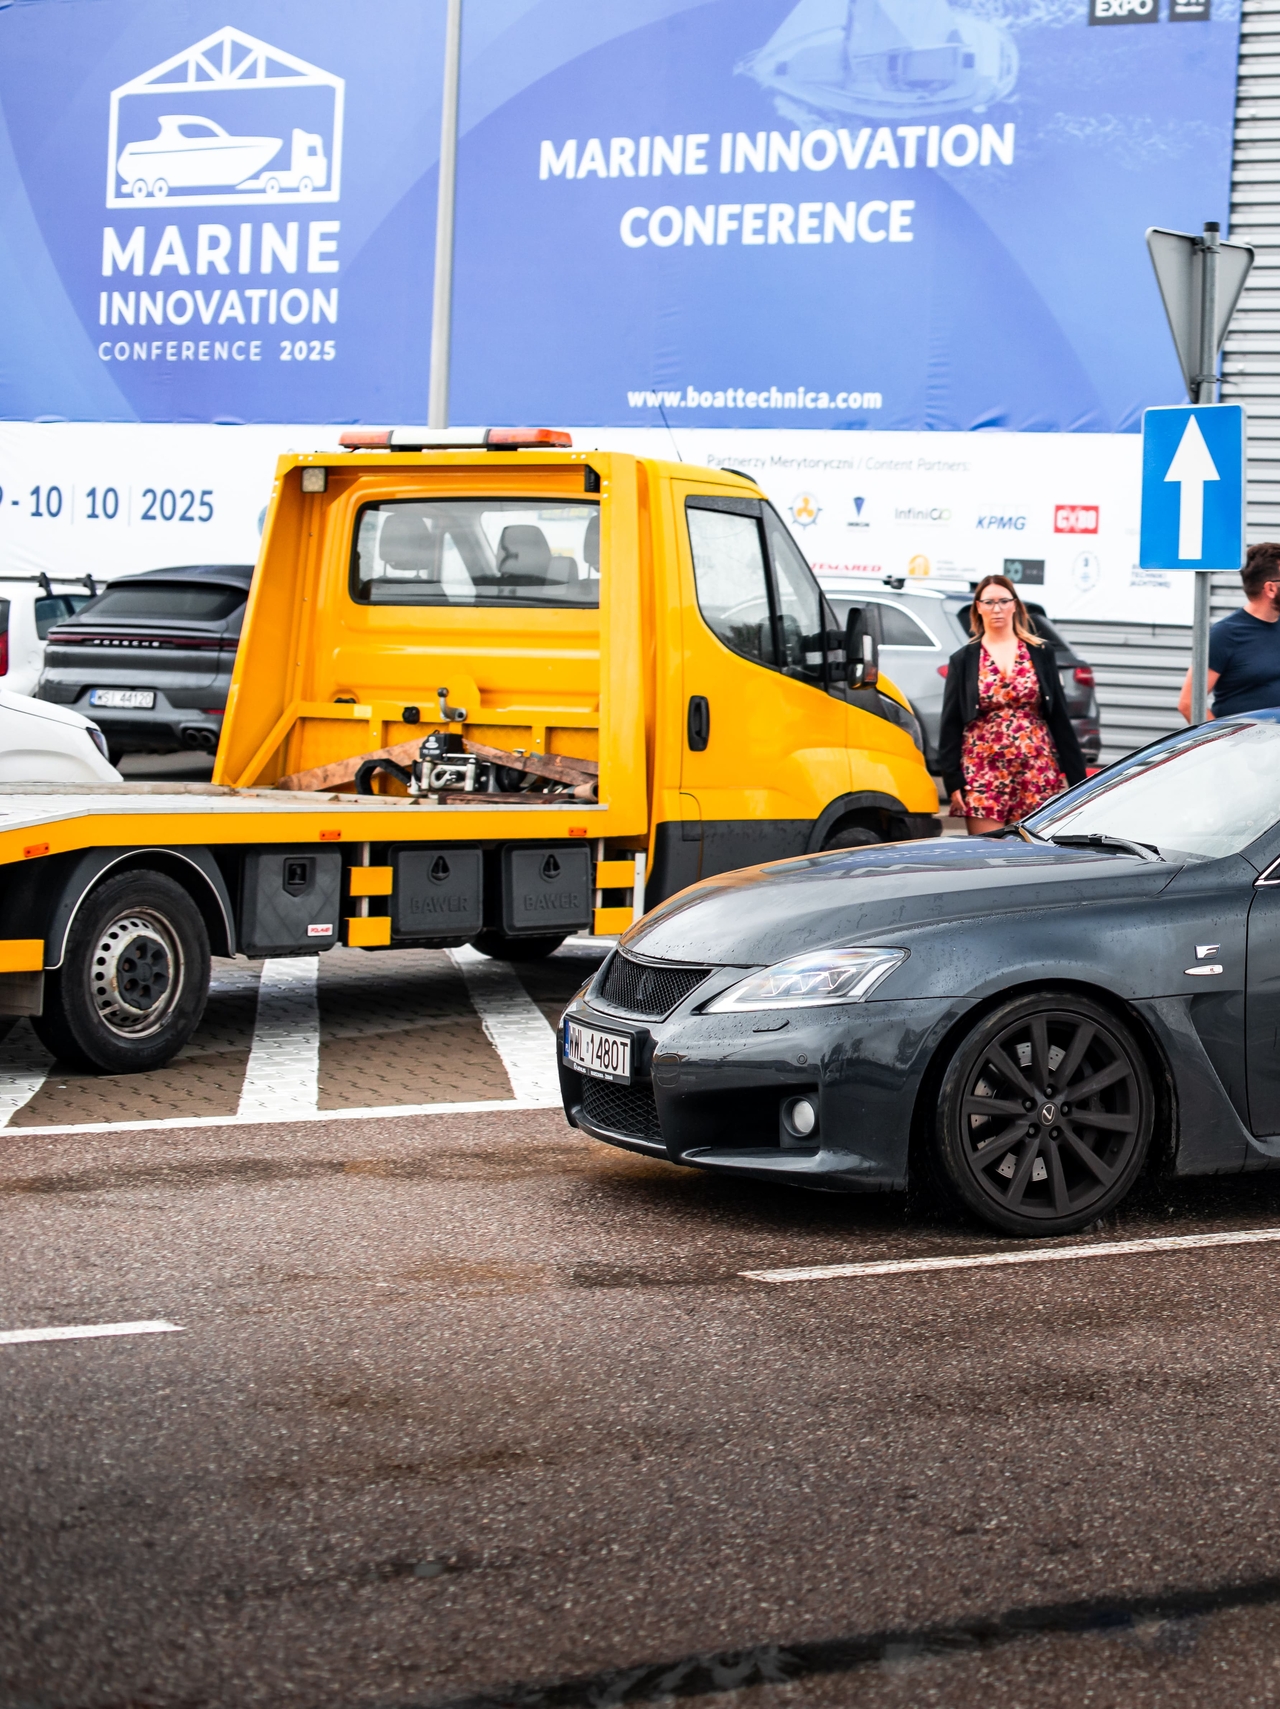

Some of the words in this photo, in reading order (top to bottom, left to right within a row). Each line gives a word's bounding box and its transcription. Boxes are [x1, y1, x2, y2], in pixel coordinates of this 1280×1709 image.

[539, 133, 710, 180] MARINE
[719, 123, 1015, 173] INNOVATION
[620, 200, 915, 248] CONFERENCE
[101, 220, 341, 277] MARINE
[99, 288, 338, 326] INNOVATION
[98, 340, 262, 361] CONFERENCE
[279, 340, 336, 361] 2025
[627, 386, 882, 410] www.boattechnica.com
[707, 454, 767, 470] Partnerzy
[770, 456, 853, 473] Merytoryczni
[866, 457, 912, 470] Content
[30, 485, 63, 518] 10
[86, 487, 119, 519] 10
[141, 488, 214, 522] 2025
[976, 515, 1027, 530] KPMG
[410, 894, 468, 914] BAWER
[523, 893, 580, 911] BAWER
[590, 1033, 629, 1075] 1480T
